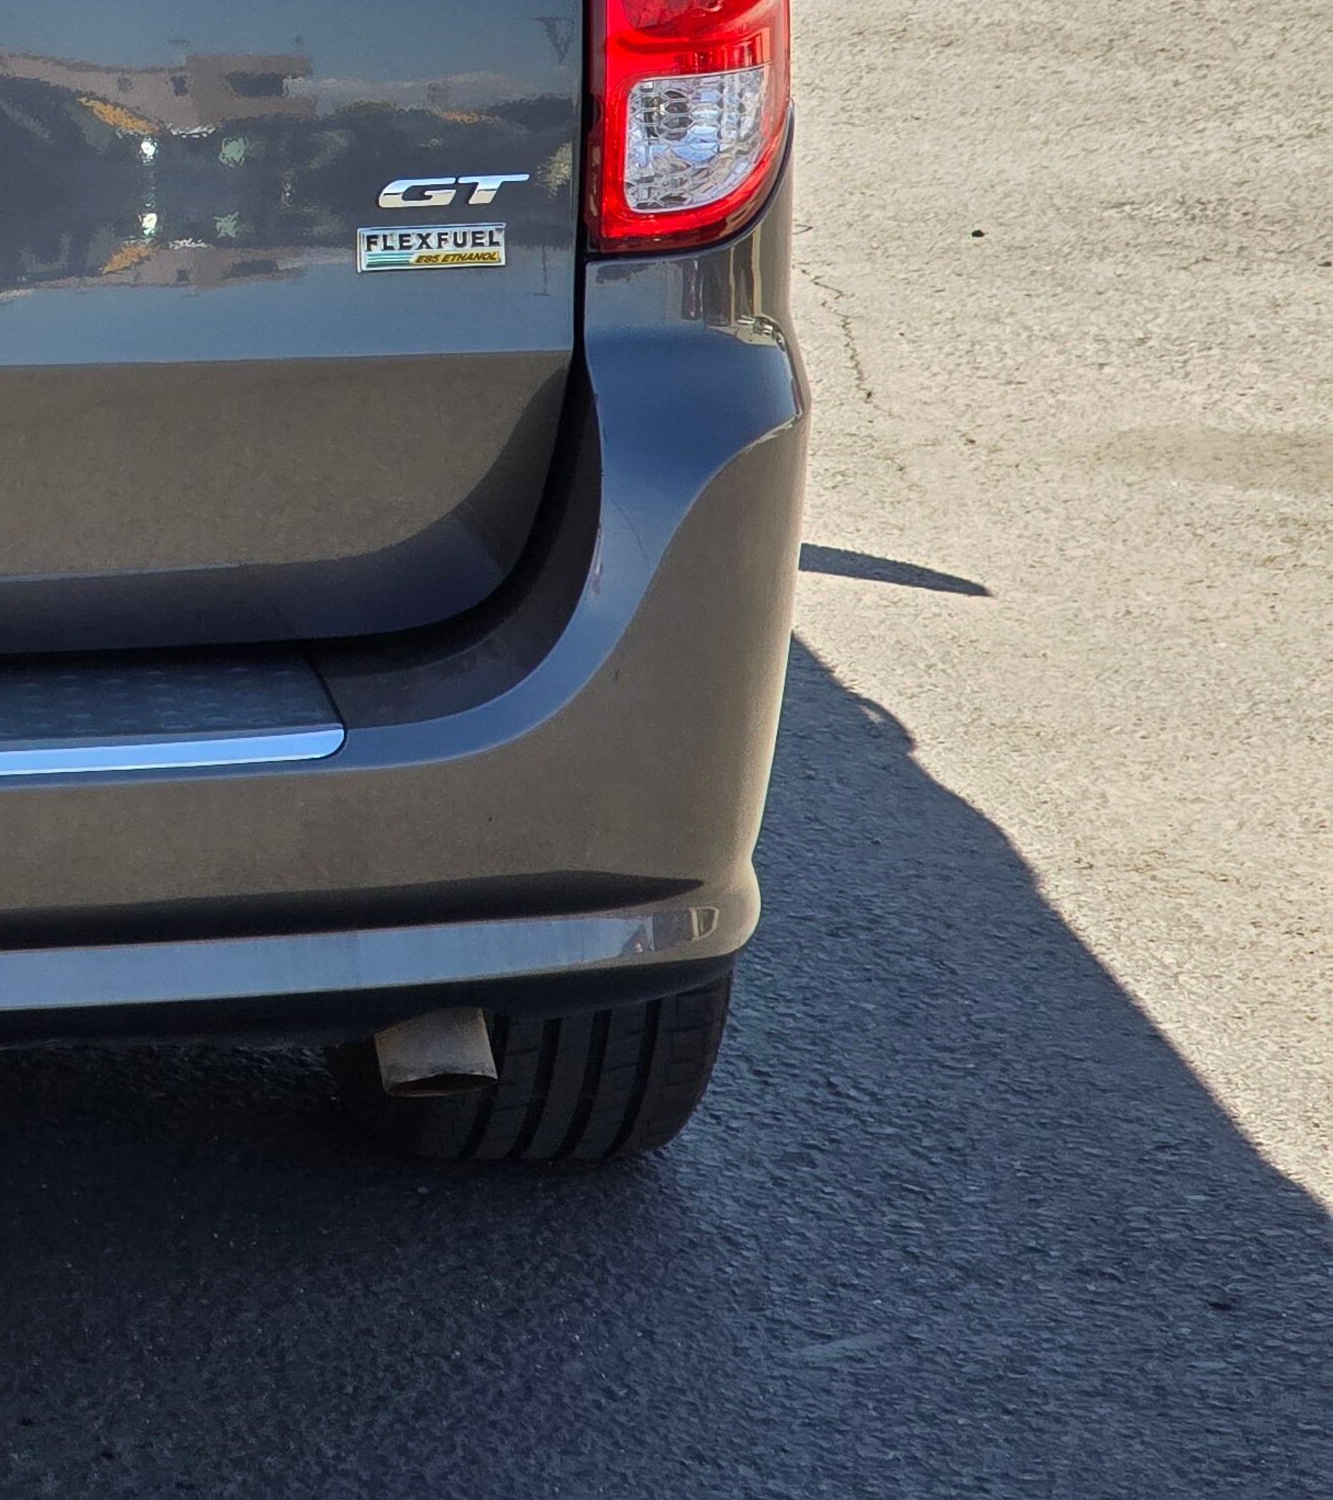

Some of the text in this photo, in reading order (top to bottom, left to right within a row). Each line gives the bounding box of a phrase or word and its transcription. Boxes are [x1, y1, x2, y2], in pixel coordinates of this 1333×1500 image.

[378, 173, 531, 208] GT
[365, 230, 501, 252] FLEXFUEL
[416, 251, 498, 263] E85 ETHANOL
